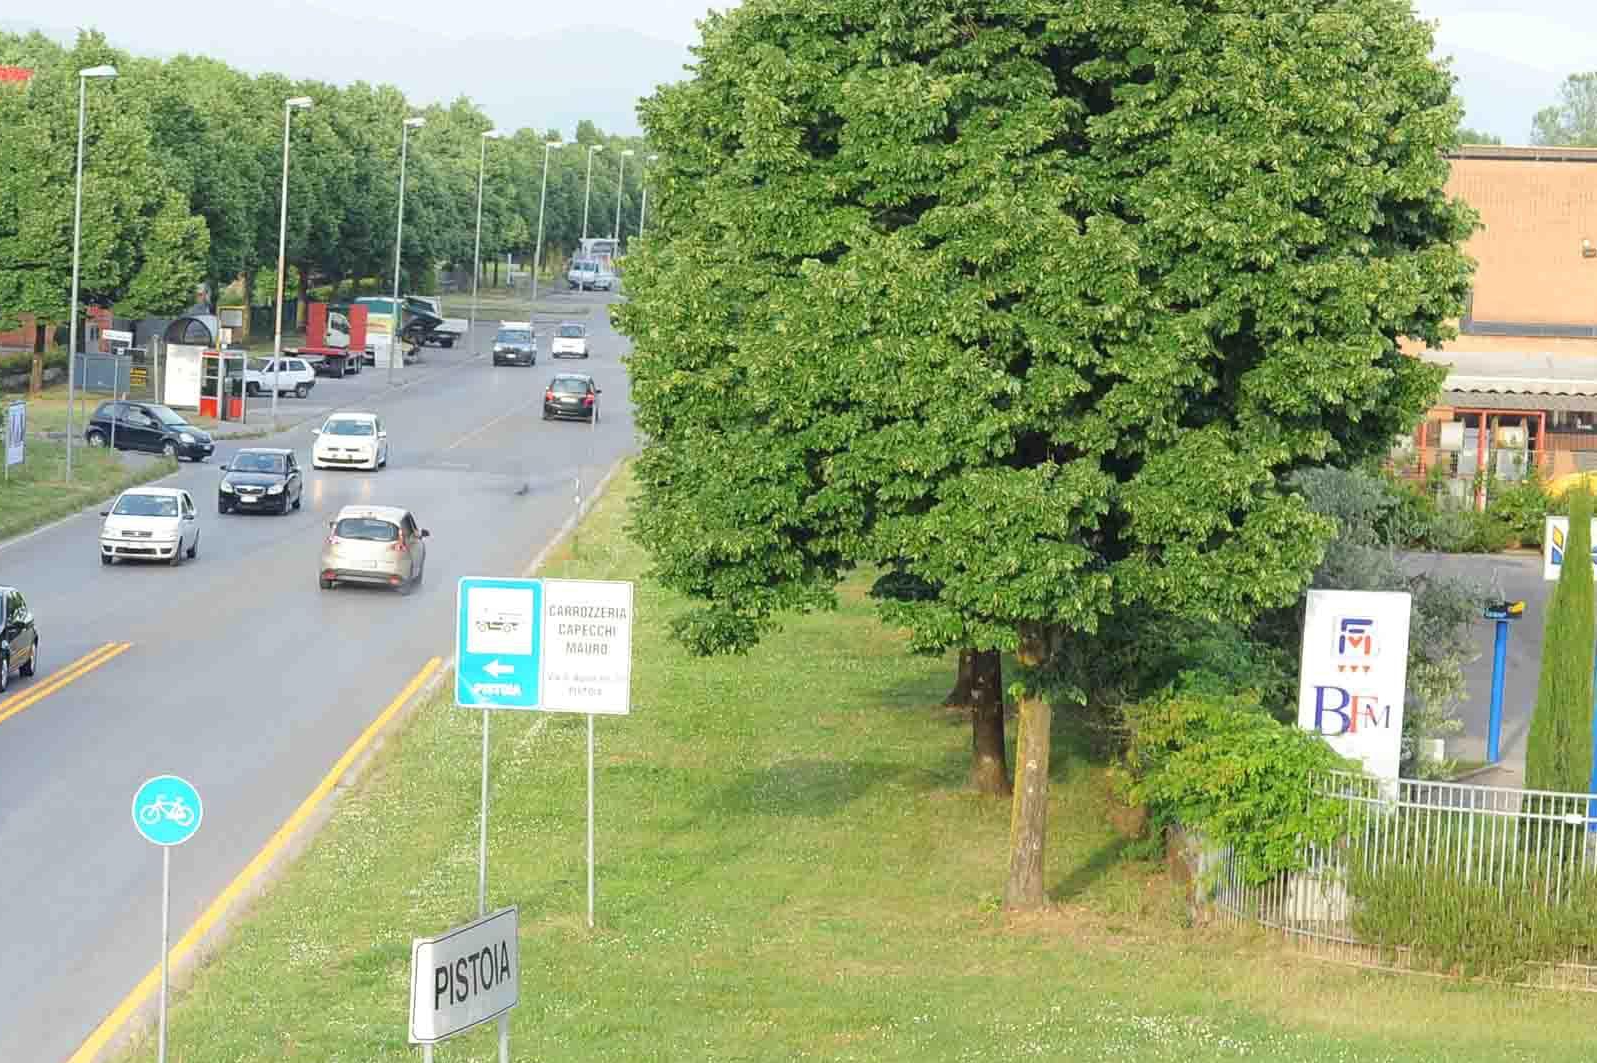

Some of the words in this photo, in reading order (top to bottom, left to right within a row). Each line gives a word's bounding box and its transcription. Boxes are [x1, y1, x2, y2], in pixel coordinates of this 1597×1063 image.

[548, 604, 628, 620] CARROZZERIA
[557, 623, 617, 638] CAPECCHI
[565, 641, 609, 656] MAURO
[1313, 685, 1391, 737] BFM
[434, 940, 511, 1011] PISTOIA
